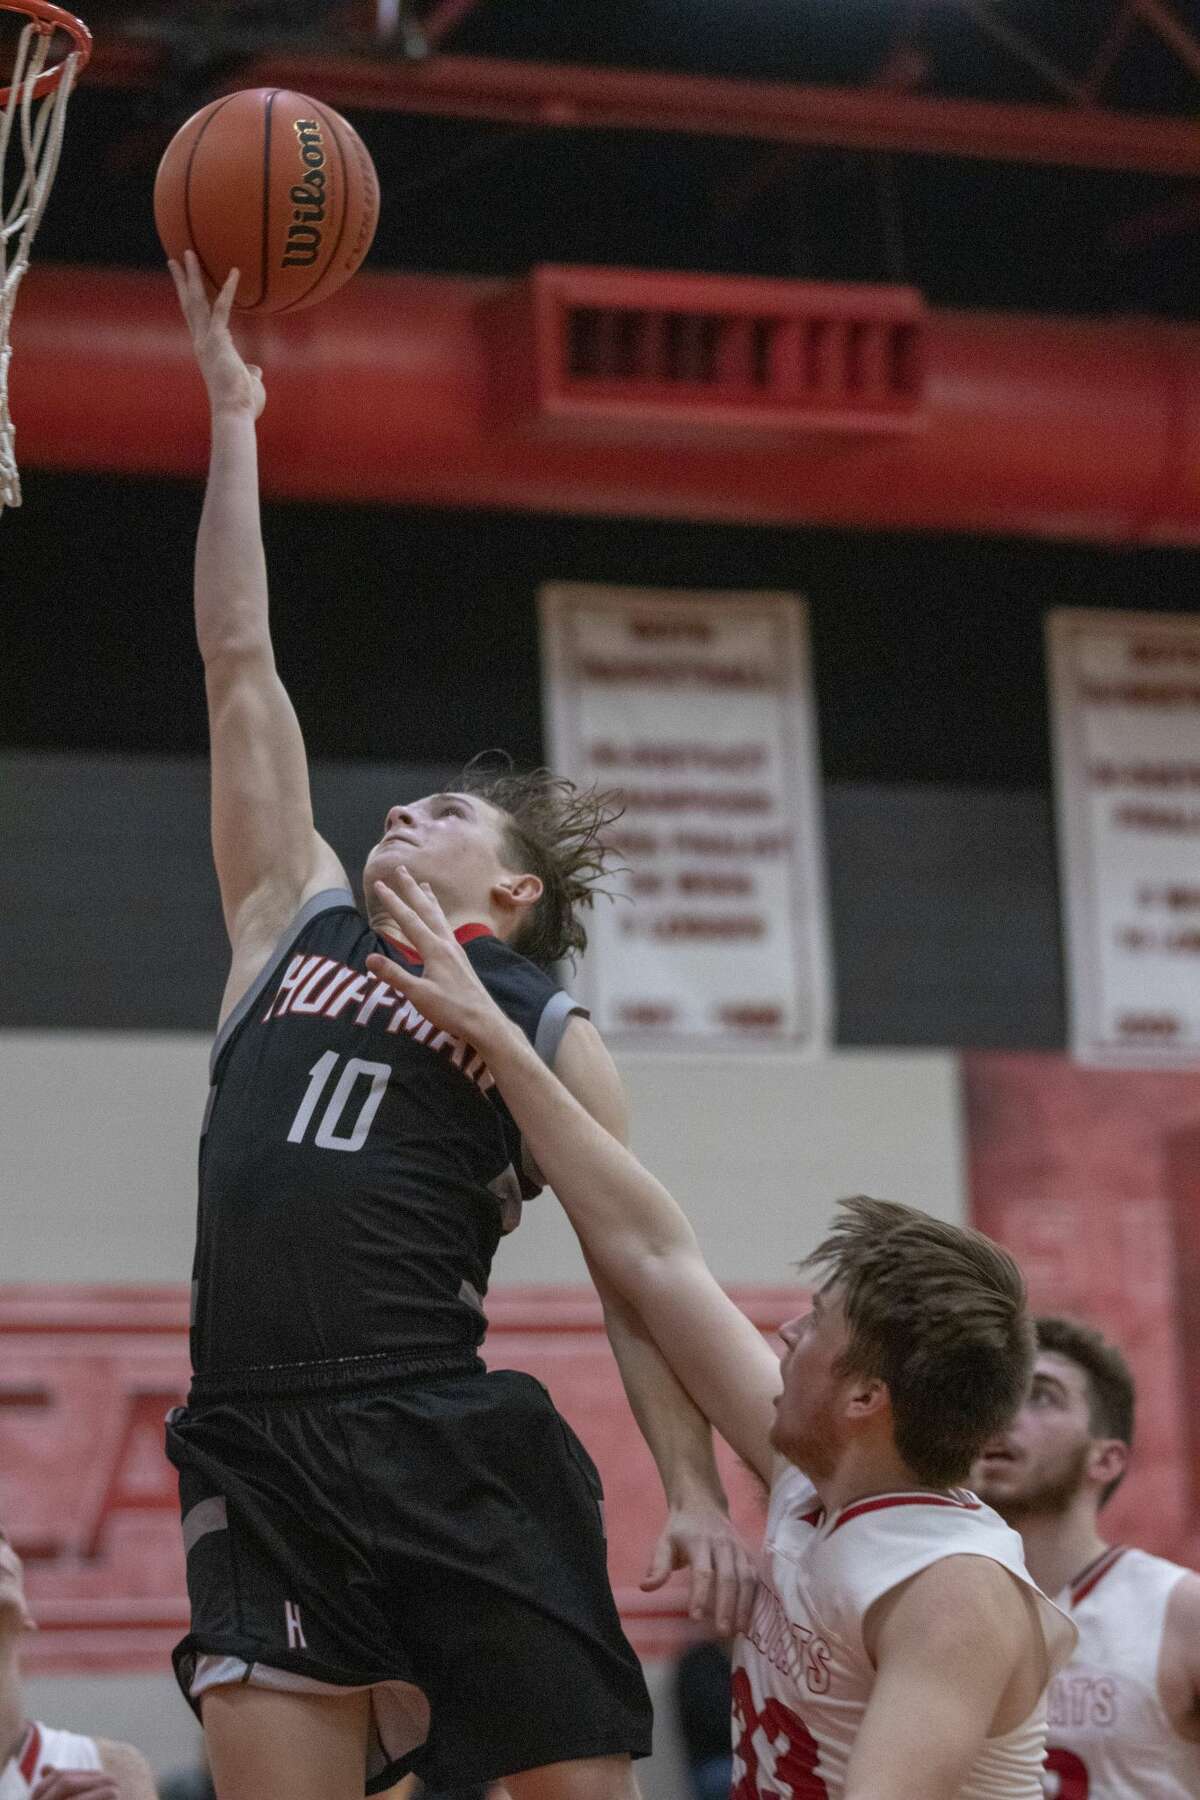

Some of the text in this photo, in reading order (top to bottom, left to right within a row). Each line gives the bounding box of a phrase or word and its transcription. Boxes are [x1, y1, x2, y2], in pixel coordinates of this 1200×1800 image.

[281, 119, 326, 268] Wilson
[287, 1050, 392, 1152] 10
[284, 1600, 307, 1648] H
